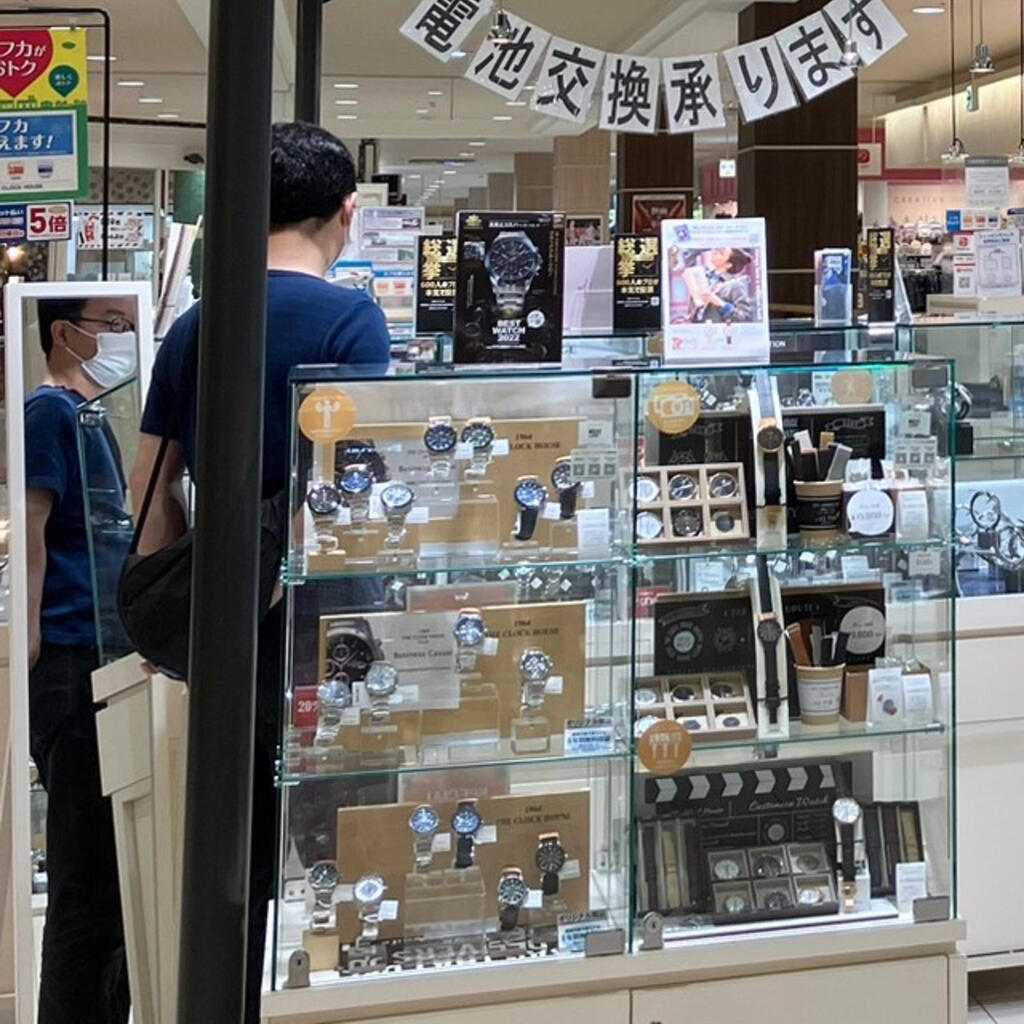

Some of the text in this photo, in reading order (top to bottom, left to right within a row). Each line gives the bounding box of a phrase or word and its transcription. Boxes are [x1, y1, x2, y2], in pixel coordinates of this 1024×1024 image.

[30, 207, 67, 234] 5倍
[492, 327, 526, 335] WATCH
[497, 334, 521, 342] 2022
[510, 442, 532, 450] LOCK
[502, 629, 530, 638] CLOCK
